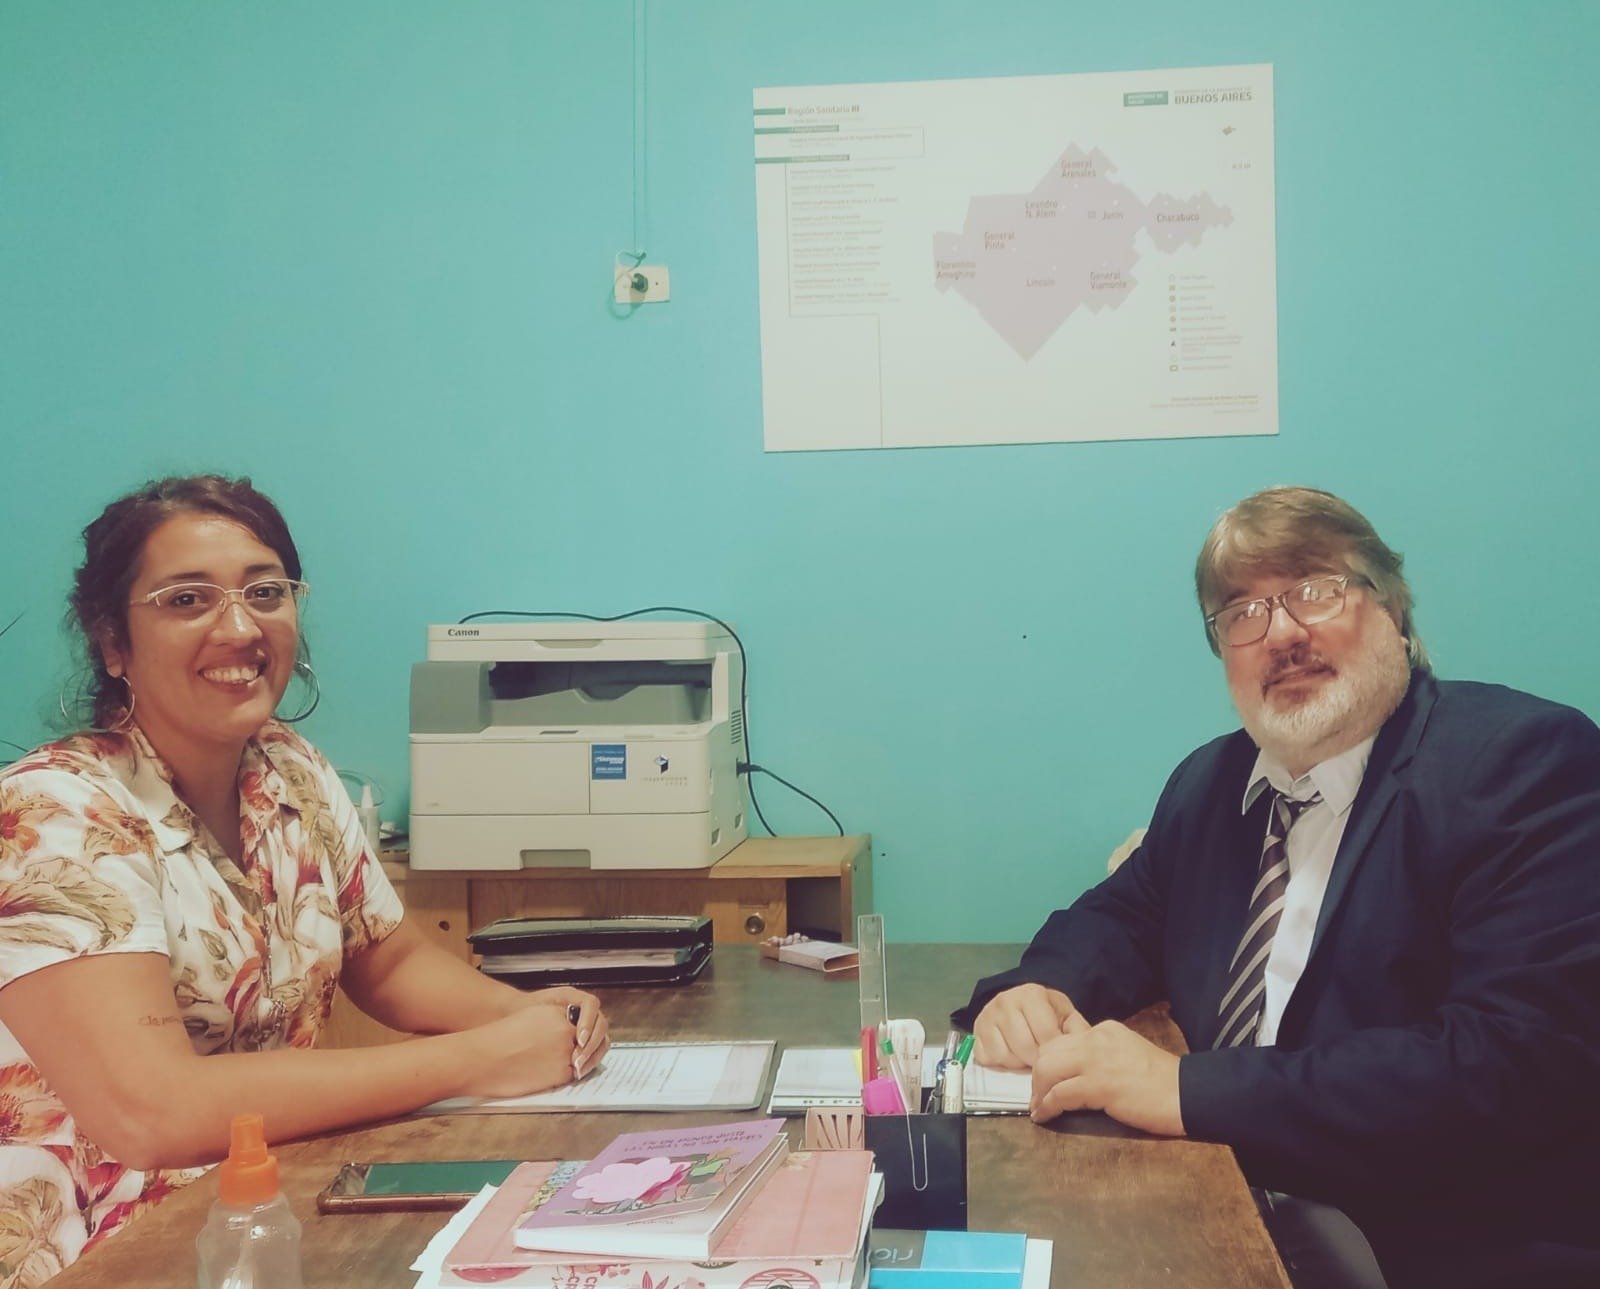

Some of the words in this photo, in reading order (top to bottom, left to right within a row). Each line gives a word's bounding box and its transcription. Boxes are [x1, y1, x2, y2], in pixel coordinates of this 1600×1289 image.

[1174, 94, 1218, 105] BUENOS
[1221, 91, 1252, 103] AIRES
[816, 104, 850, 114] Sanitaria
[1060, 159, 1093, 169] General
[1061, 169, 1097, 178] Arenales
[1025, 200, 1058, 209] Leandro
[1156, 213, 1200, 223] Chacabuco
[984, 231, 1016, 241] General
[1089, 271, 1120, 281] General
[447, 628, 480, 637] Canon
